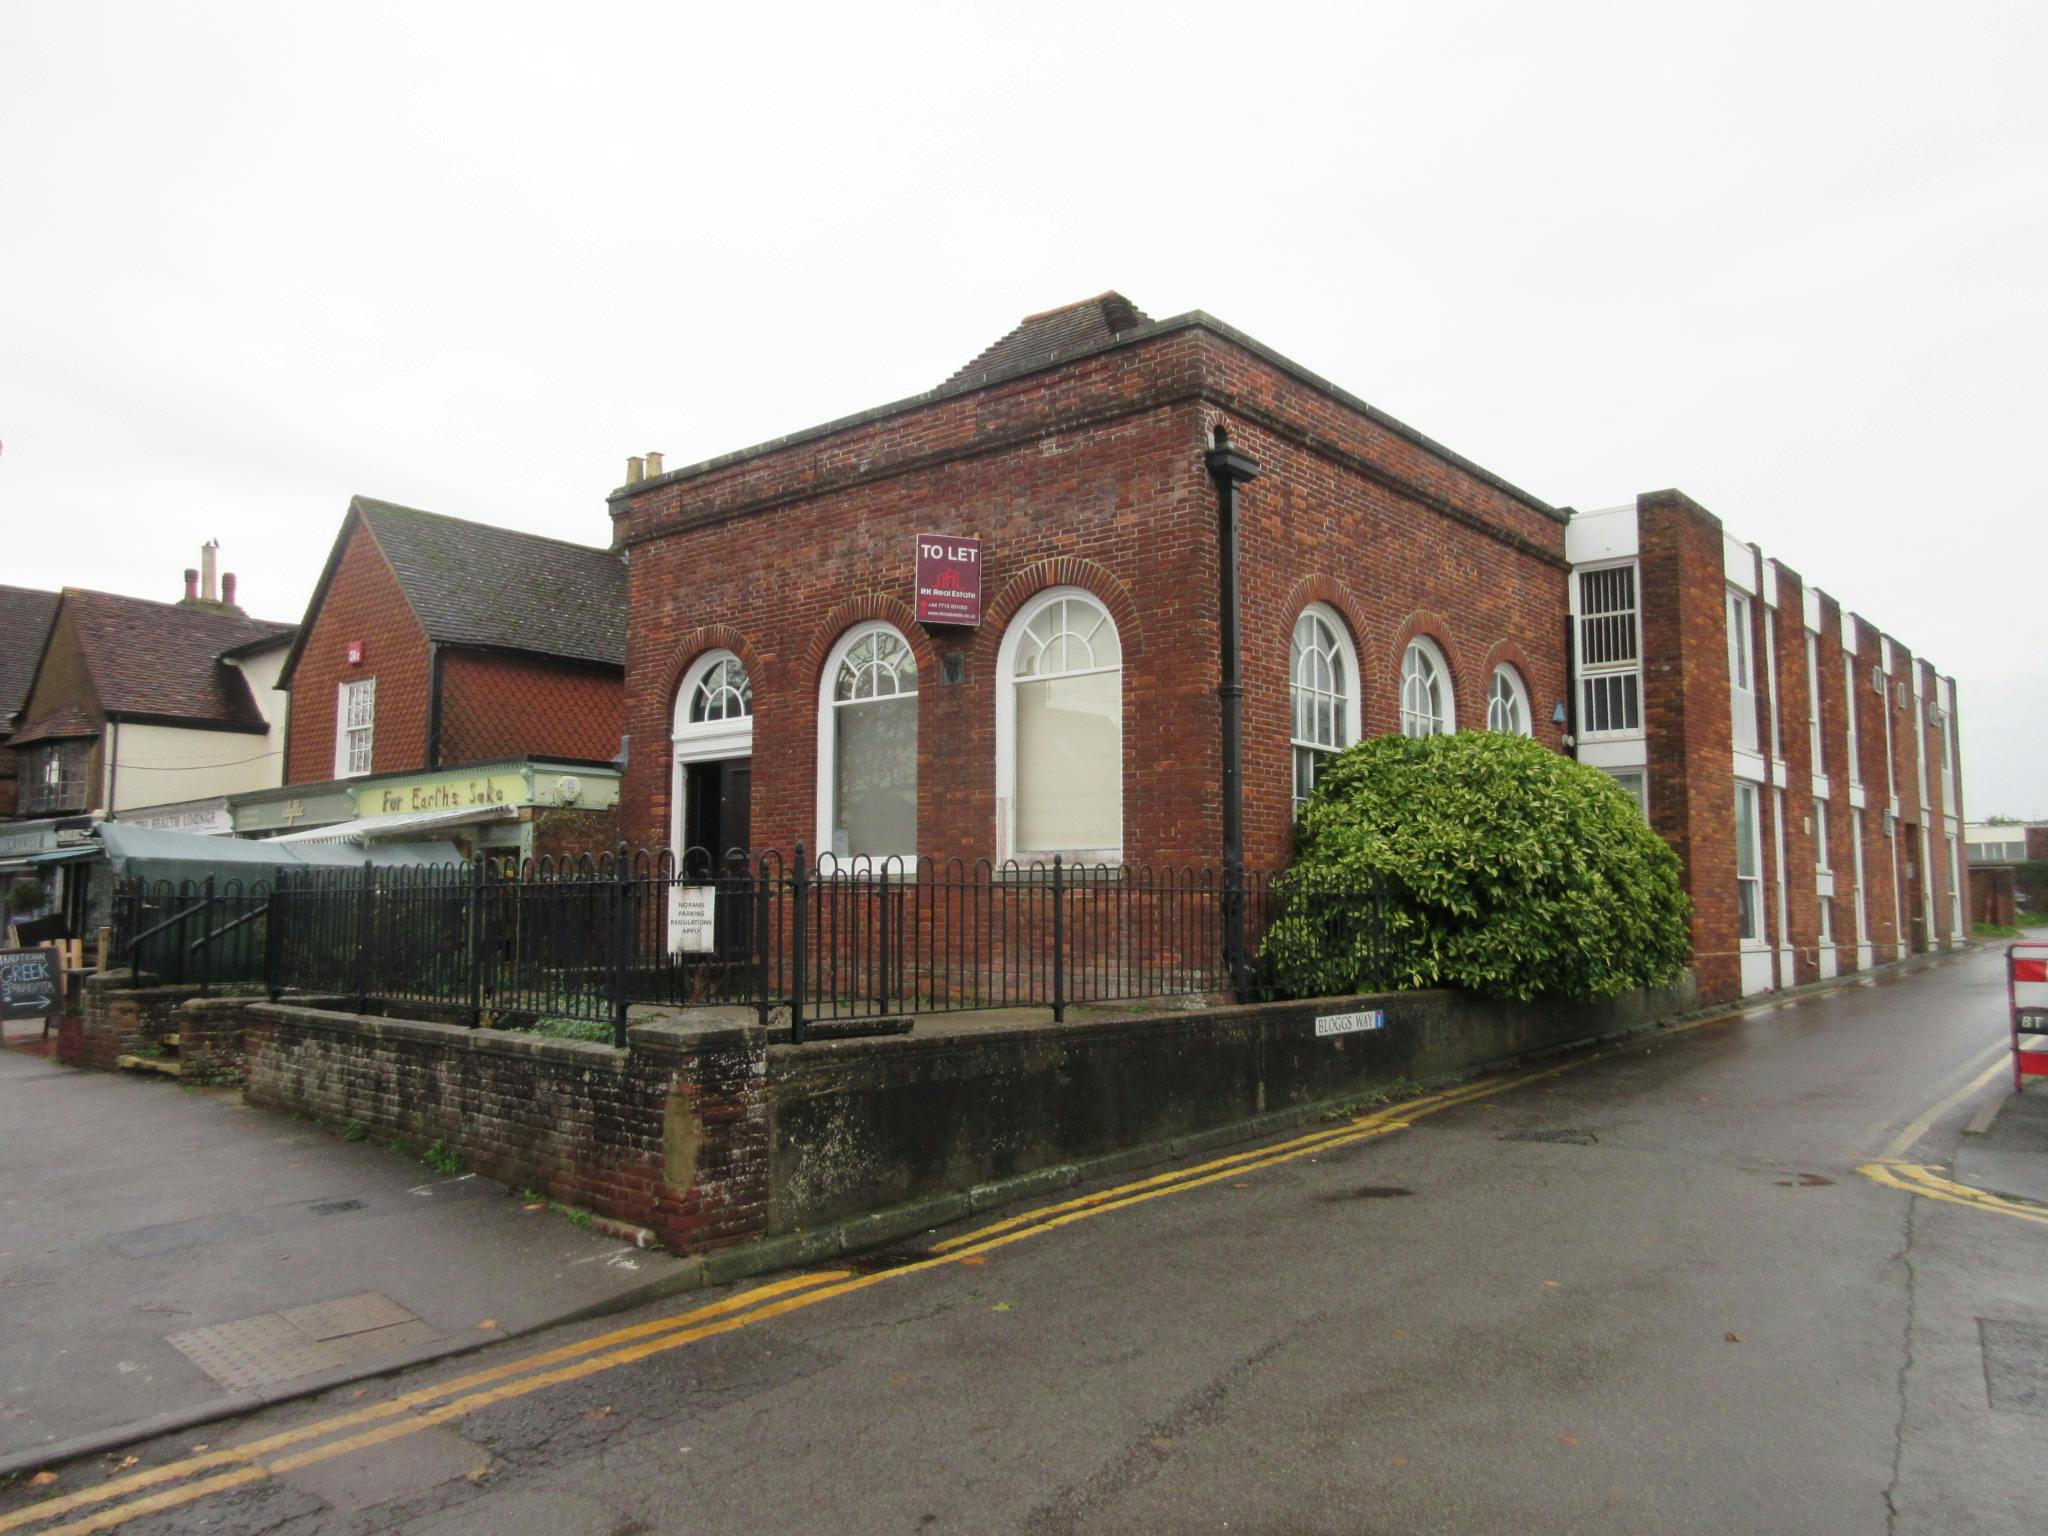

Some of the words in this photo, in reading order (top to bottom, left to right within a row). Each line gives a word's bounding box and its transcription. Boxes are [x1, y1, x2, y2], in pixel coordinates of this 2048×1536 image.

[921, 544, 943, 559] TO
[948, 546, 977, 562] LET
[920, 588, 932, 596] RK
[933, 589, 951, 597] Real
[951, 590, 976, 599] Estate
[382, 789, 402, 812] For
[412, 784, 459, 810] Earth's
[151, 814, 180, 829] HEALTH
[183, 811, 216, 827] LOUNGE
[1, 963, 50, 983] GREEK
[1318, 1015, 1352, 1033] BLOGGS
[1355, 1013, 1373, 1028] WAY
[2022, 1015, 2044, 1029] BT
